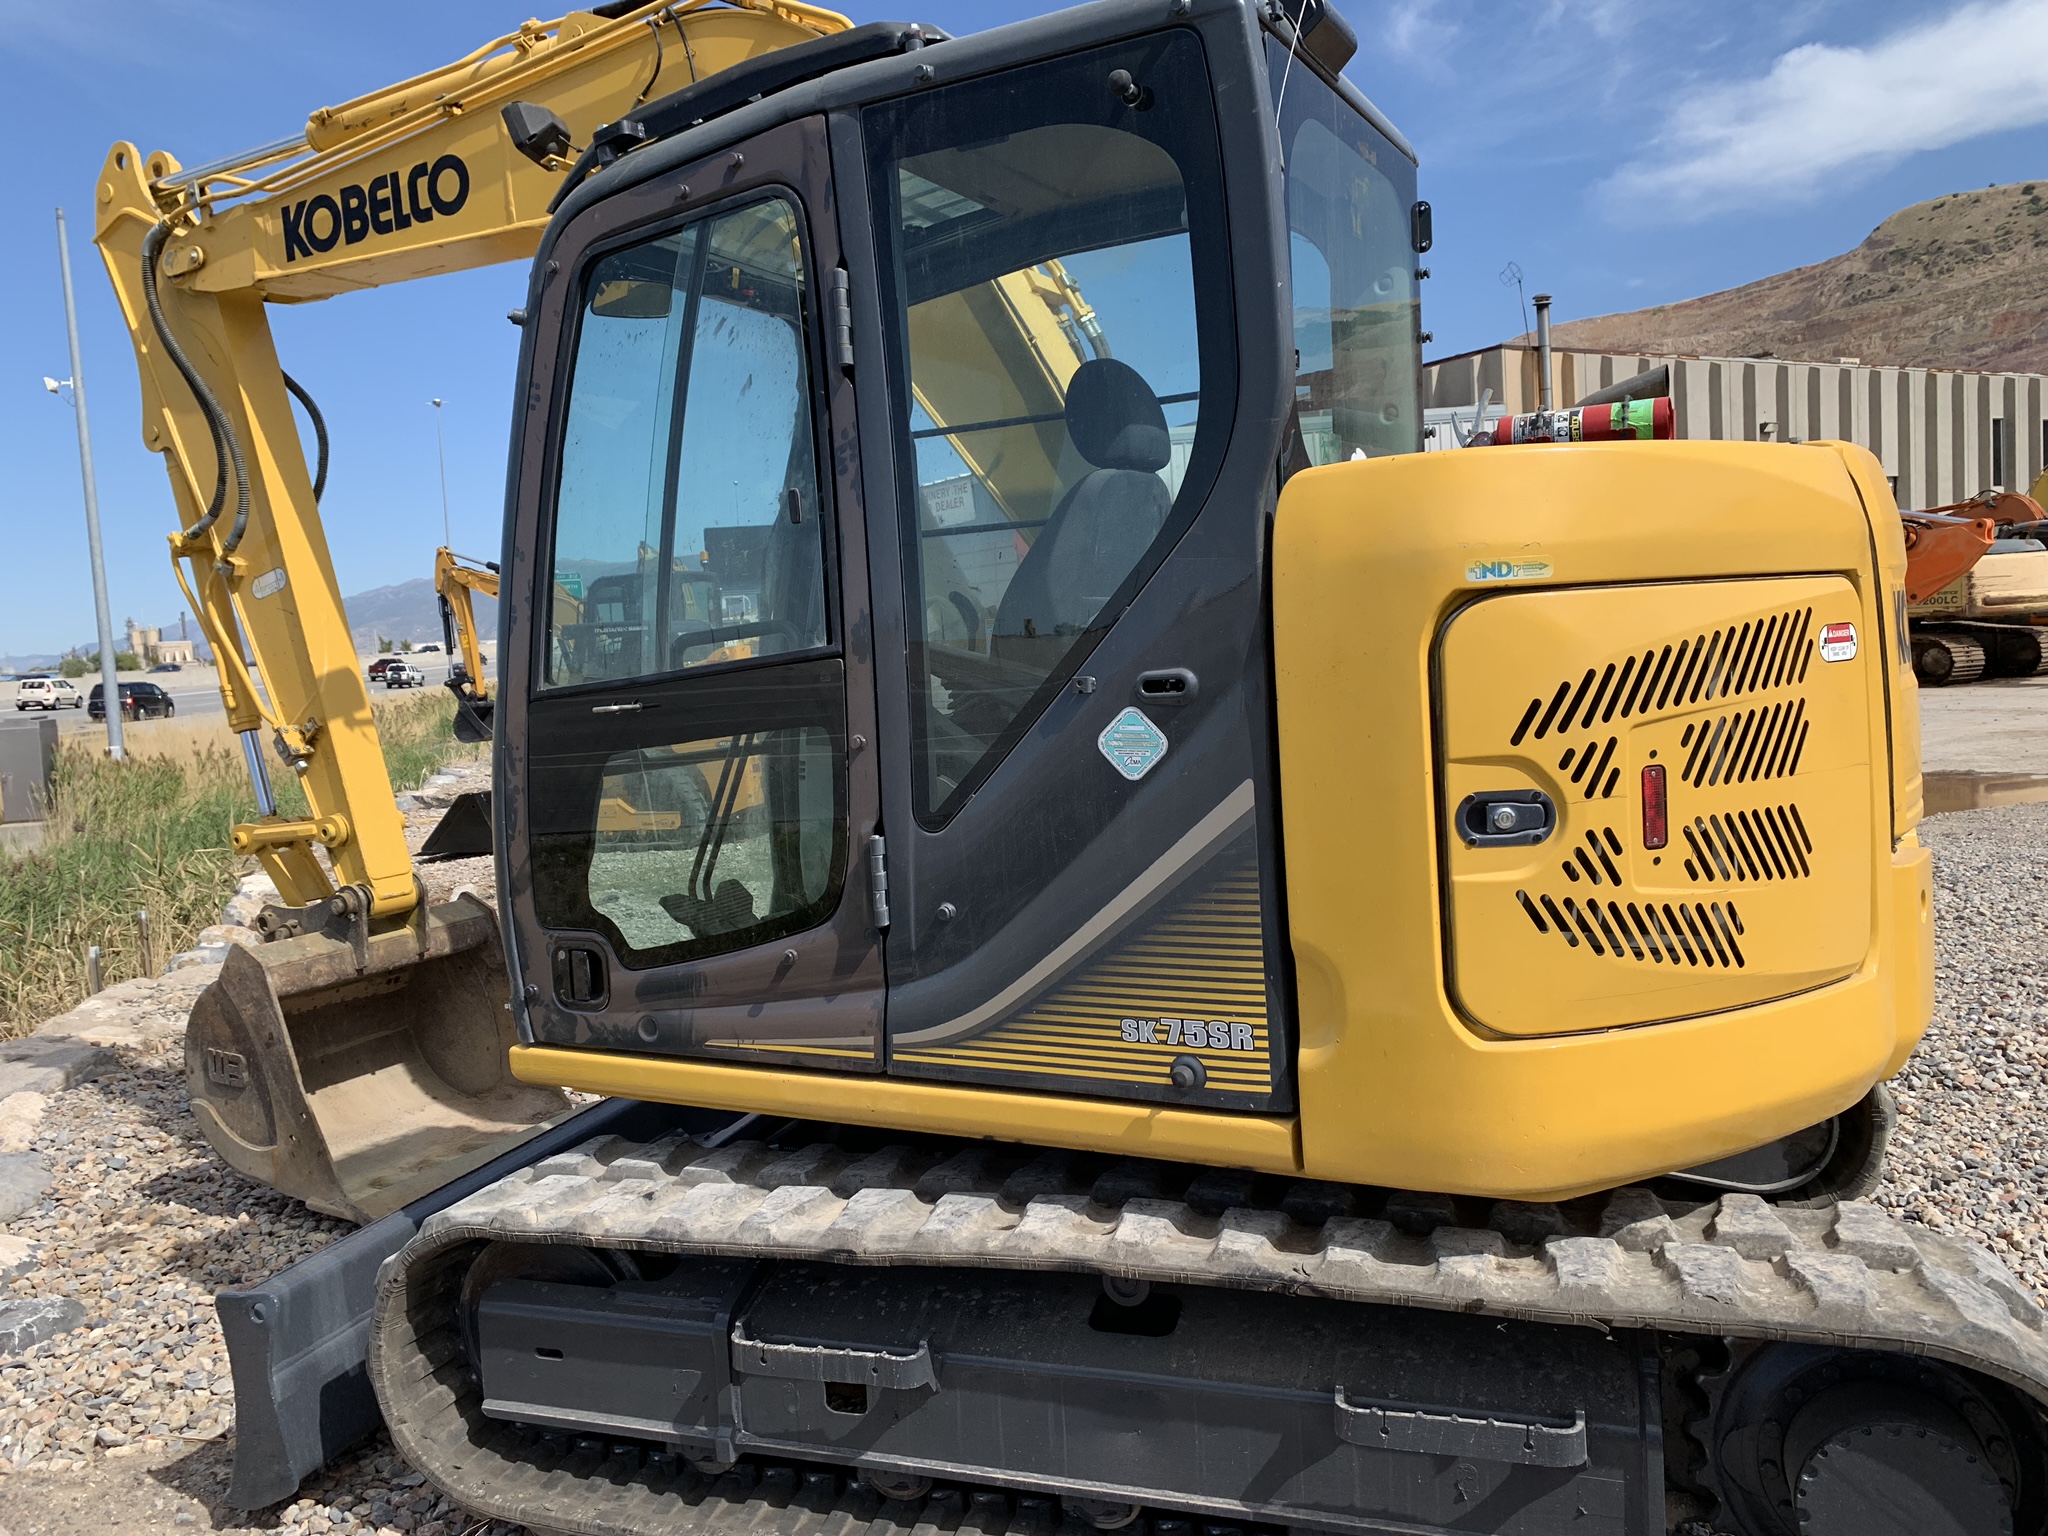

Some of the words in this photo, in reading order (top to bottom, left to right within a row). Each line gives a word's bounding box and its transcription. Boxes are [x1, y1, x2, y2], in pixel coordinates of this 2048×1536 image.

[281, 154, 470, 262] KOBELCO
[953, 482, 968, 495] THE
[935, 496, 965, 512] DEALER
